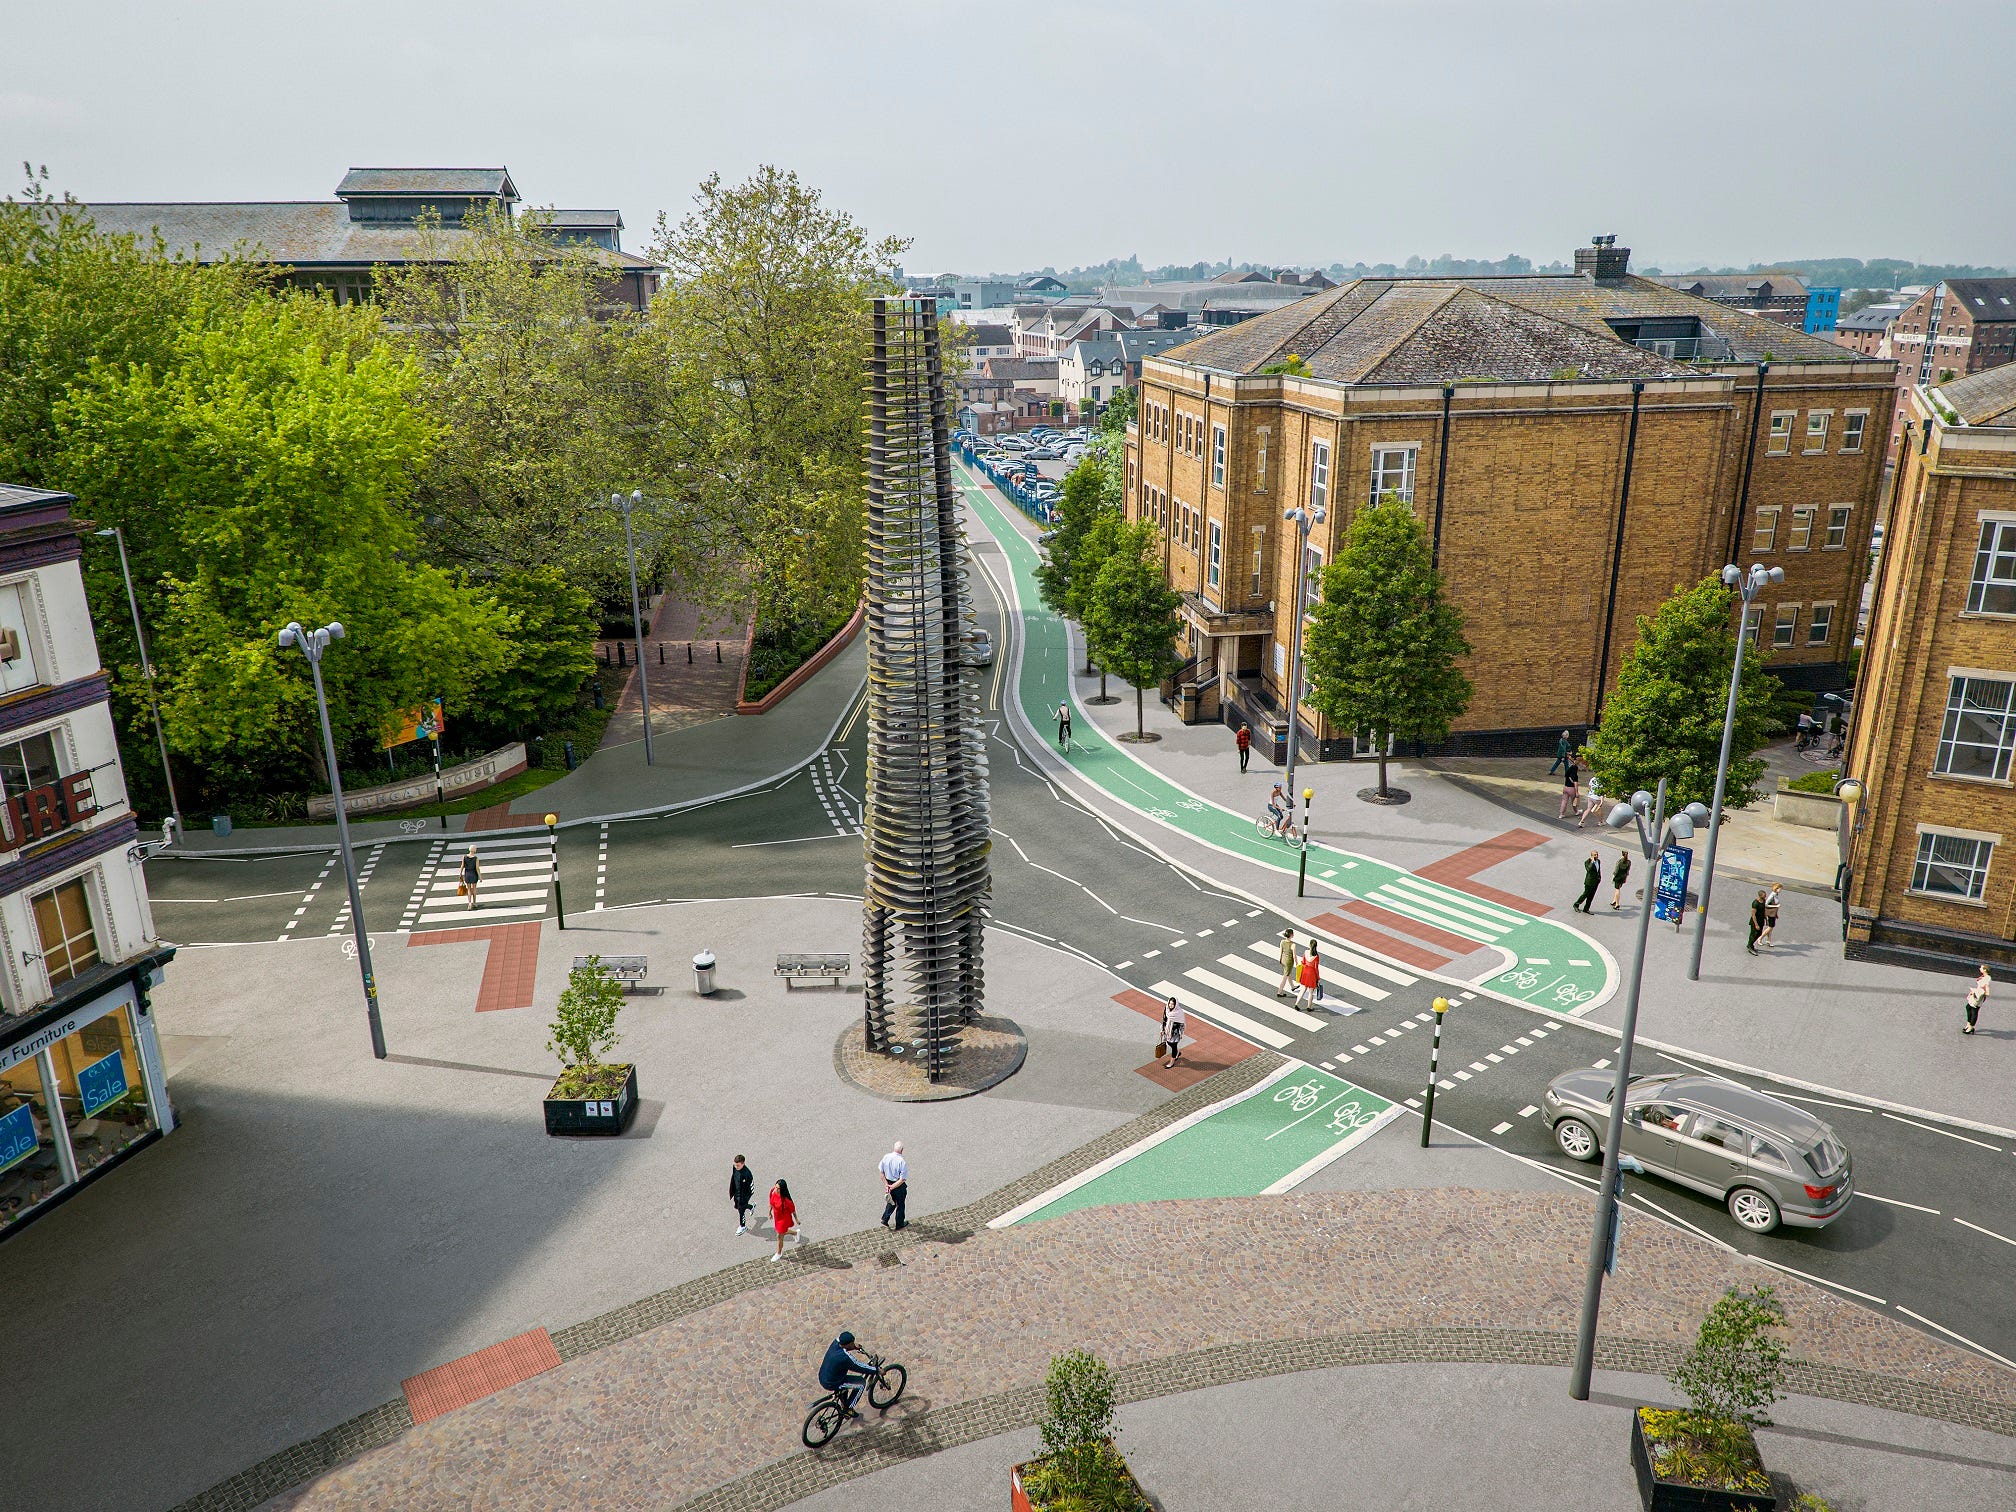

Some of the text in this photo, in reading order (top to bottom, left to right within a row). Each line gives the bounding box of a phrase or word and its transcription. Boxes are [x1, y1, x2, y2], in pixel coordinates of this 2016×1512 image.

[1901, 334, 1969, 344] ALBERT WAREHOUSE
[12, 1020, 75, 1060] Furniture
[87, 1079, 122, 1108] Sale
